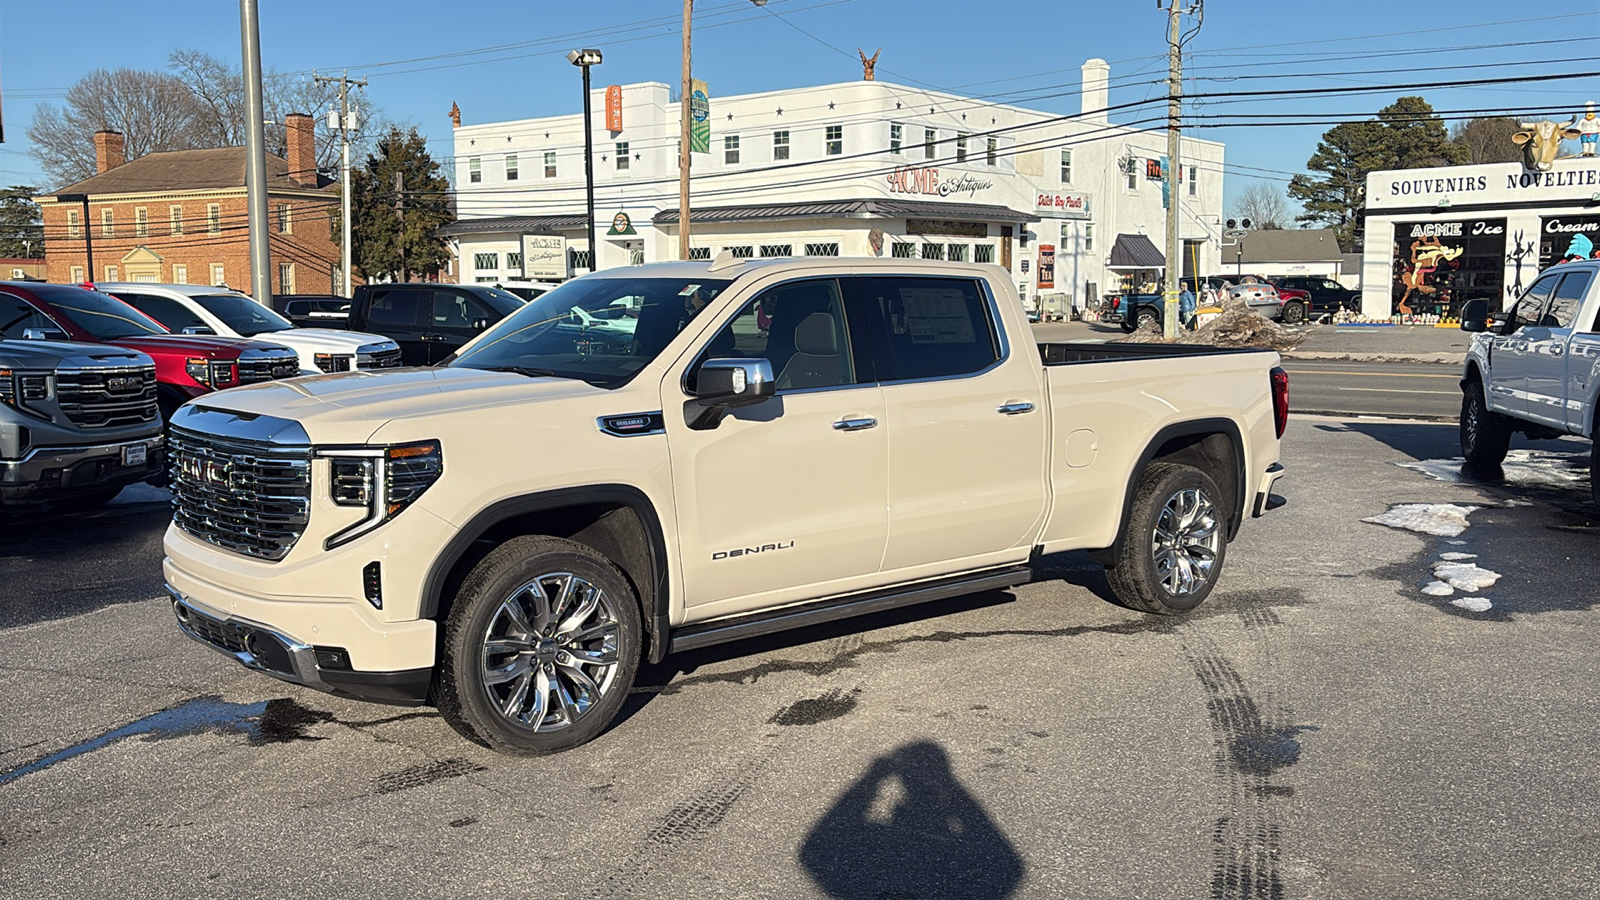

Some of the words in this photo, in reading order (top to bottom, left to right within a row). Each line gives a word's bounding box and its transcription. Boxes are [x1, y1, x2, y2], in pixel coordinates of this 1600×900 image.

[887, 165, 939, 196] ACME
[938, 172, 993, 198] Antiques
[1391, 176, 1487, 196] SOUVENIRS
[1507, 170, 1600, 189] NOVELTIE
[1038, 194, 1053, 206] Dutch
[1055, 195, 1065, 209] Boy
[1065, 196, 1082, 208] Paints
[1410, 222, 1463, 238] ACME
[1472, 221, 1504, 235] Ice
[1545, 219, 1600, 233] Cream
[1041, 269, 1052, 280] TEA
[108, 377, 143, 390] GMC
[181, 453, 229, 489] GMC
[712, 540, 795, 560] DENALI
